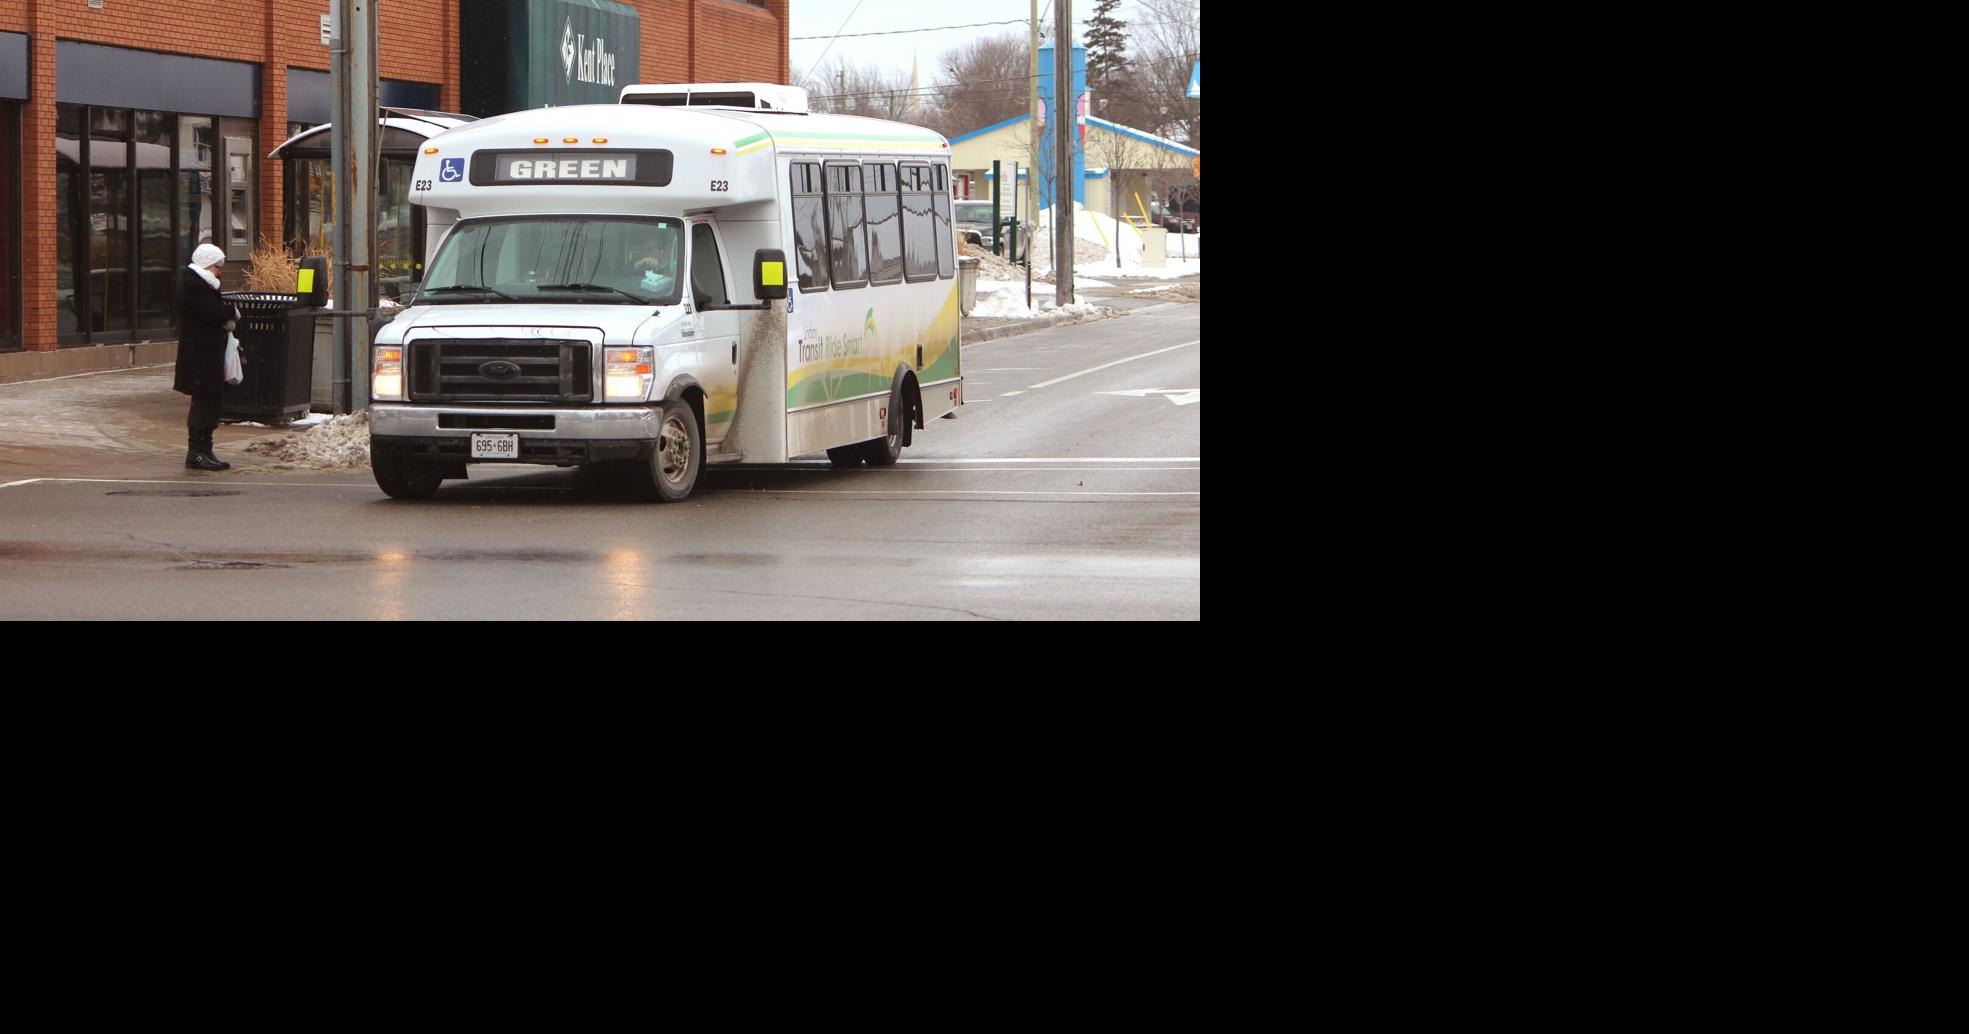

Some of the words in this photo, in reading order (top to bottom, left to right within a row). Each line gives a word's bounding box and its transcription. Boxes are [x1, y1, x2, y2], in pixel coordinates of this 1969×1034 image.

[577, 33, 595, 83] Kent
[596, 37, 615, 87] Place
[510, 160, 627, 178] GREEN
[415, 180, 432, 191] E23
[710, 180, 729, 192] E23
[798, 336, 823, 363] Transit
[826, 336, 841, 359] Ride
[476, 440, 492, 452] 695
